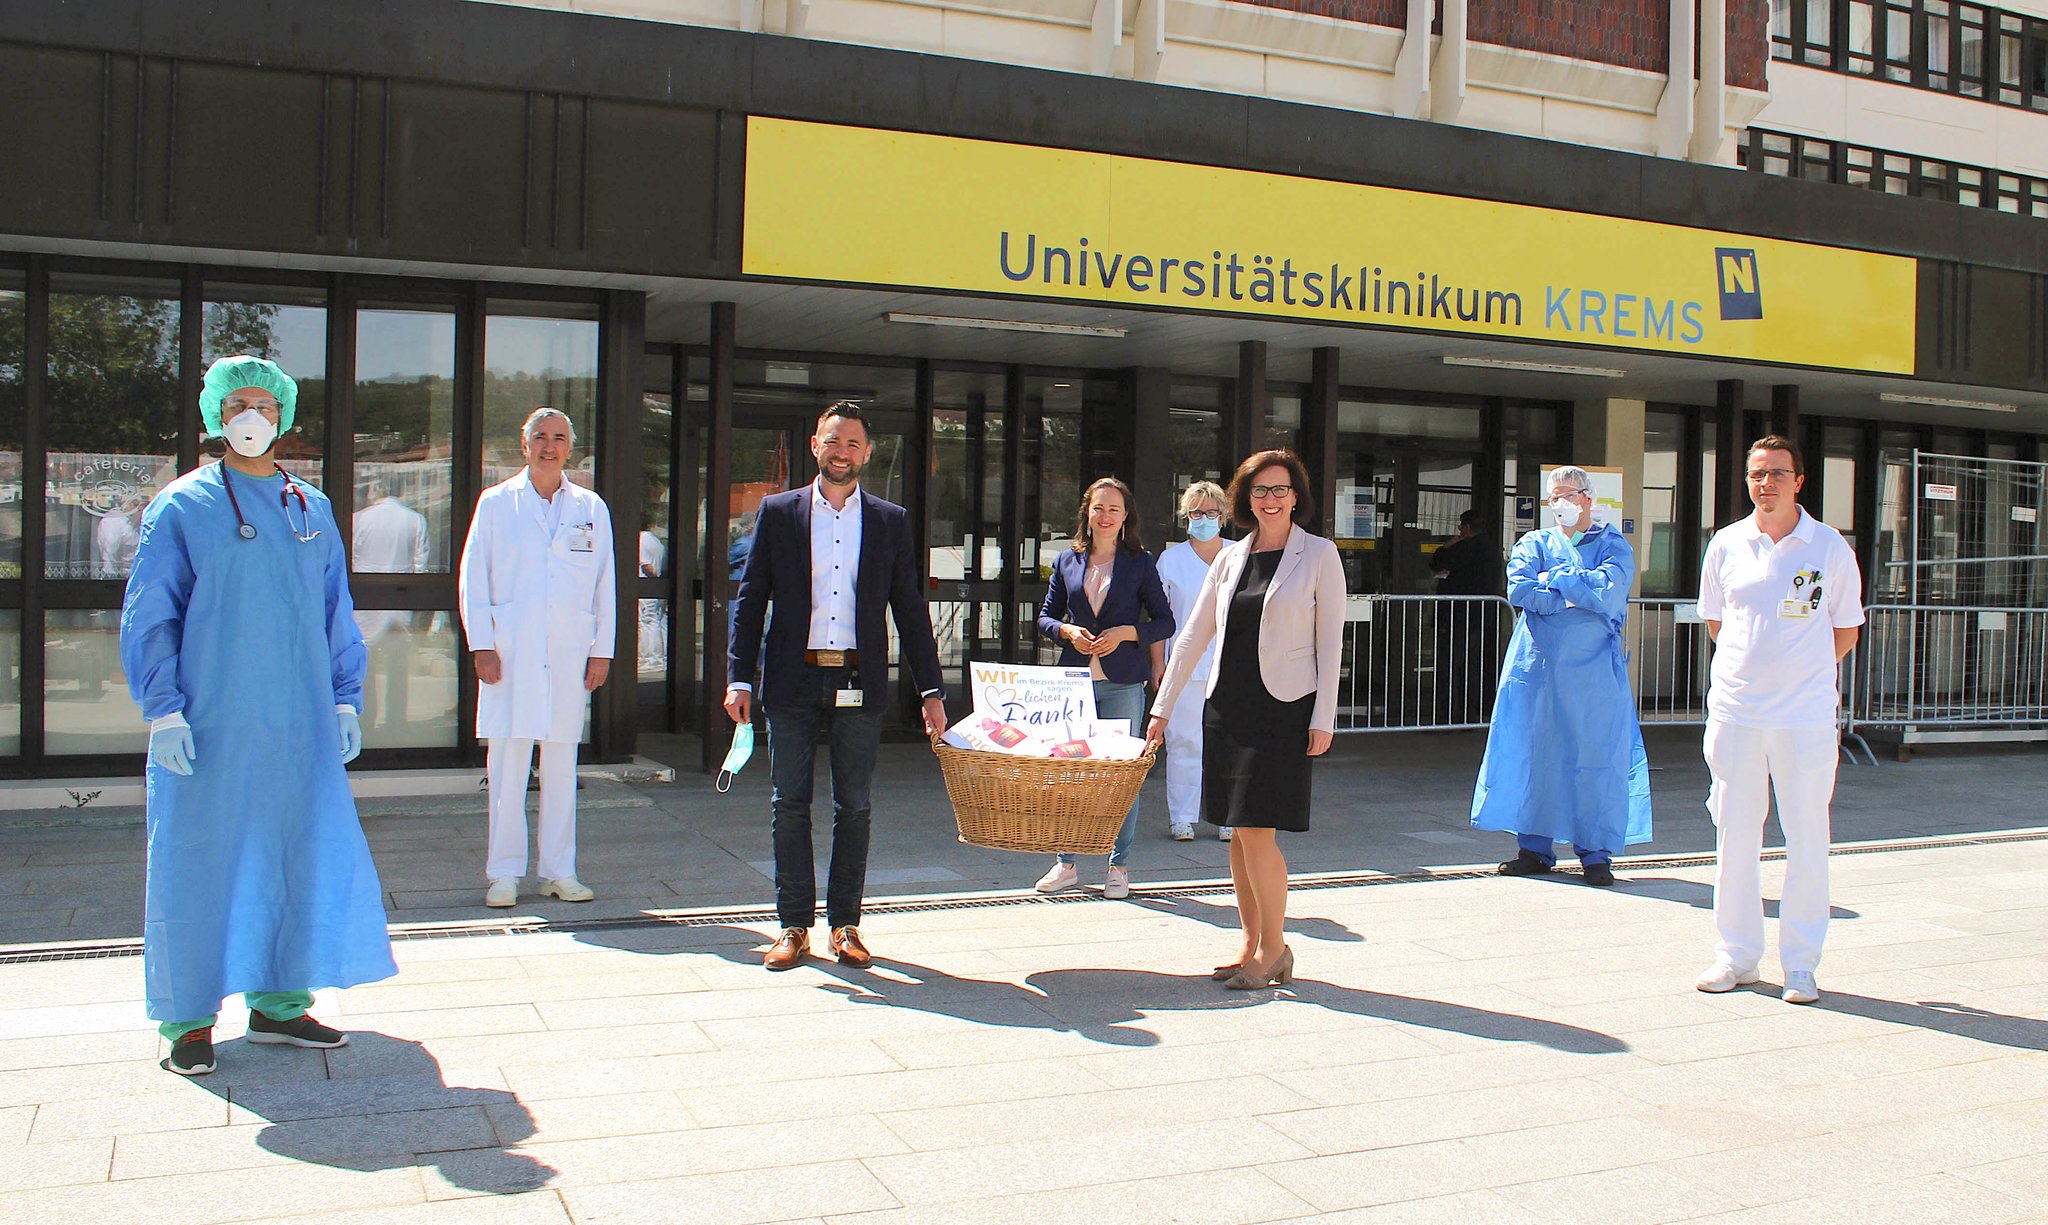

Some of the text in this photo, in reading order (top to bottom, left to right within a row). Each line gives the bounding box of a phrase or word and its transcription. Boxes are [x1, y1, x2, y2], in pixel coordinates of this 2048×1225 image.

[1000, 231, 1704, 344] Universitätsklinikum KREMS
[1721, 255, 1755, 294] N
[74, 458, 153, 485] cafeteria
[976, 666, 1018, 684] wir
[1029, 678, 1055, 686] Bezirk
[1057, 679, 1085, 687] Krems
[1001, 697, 1084, 726] Dank!
